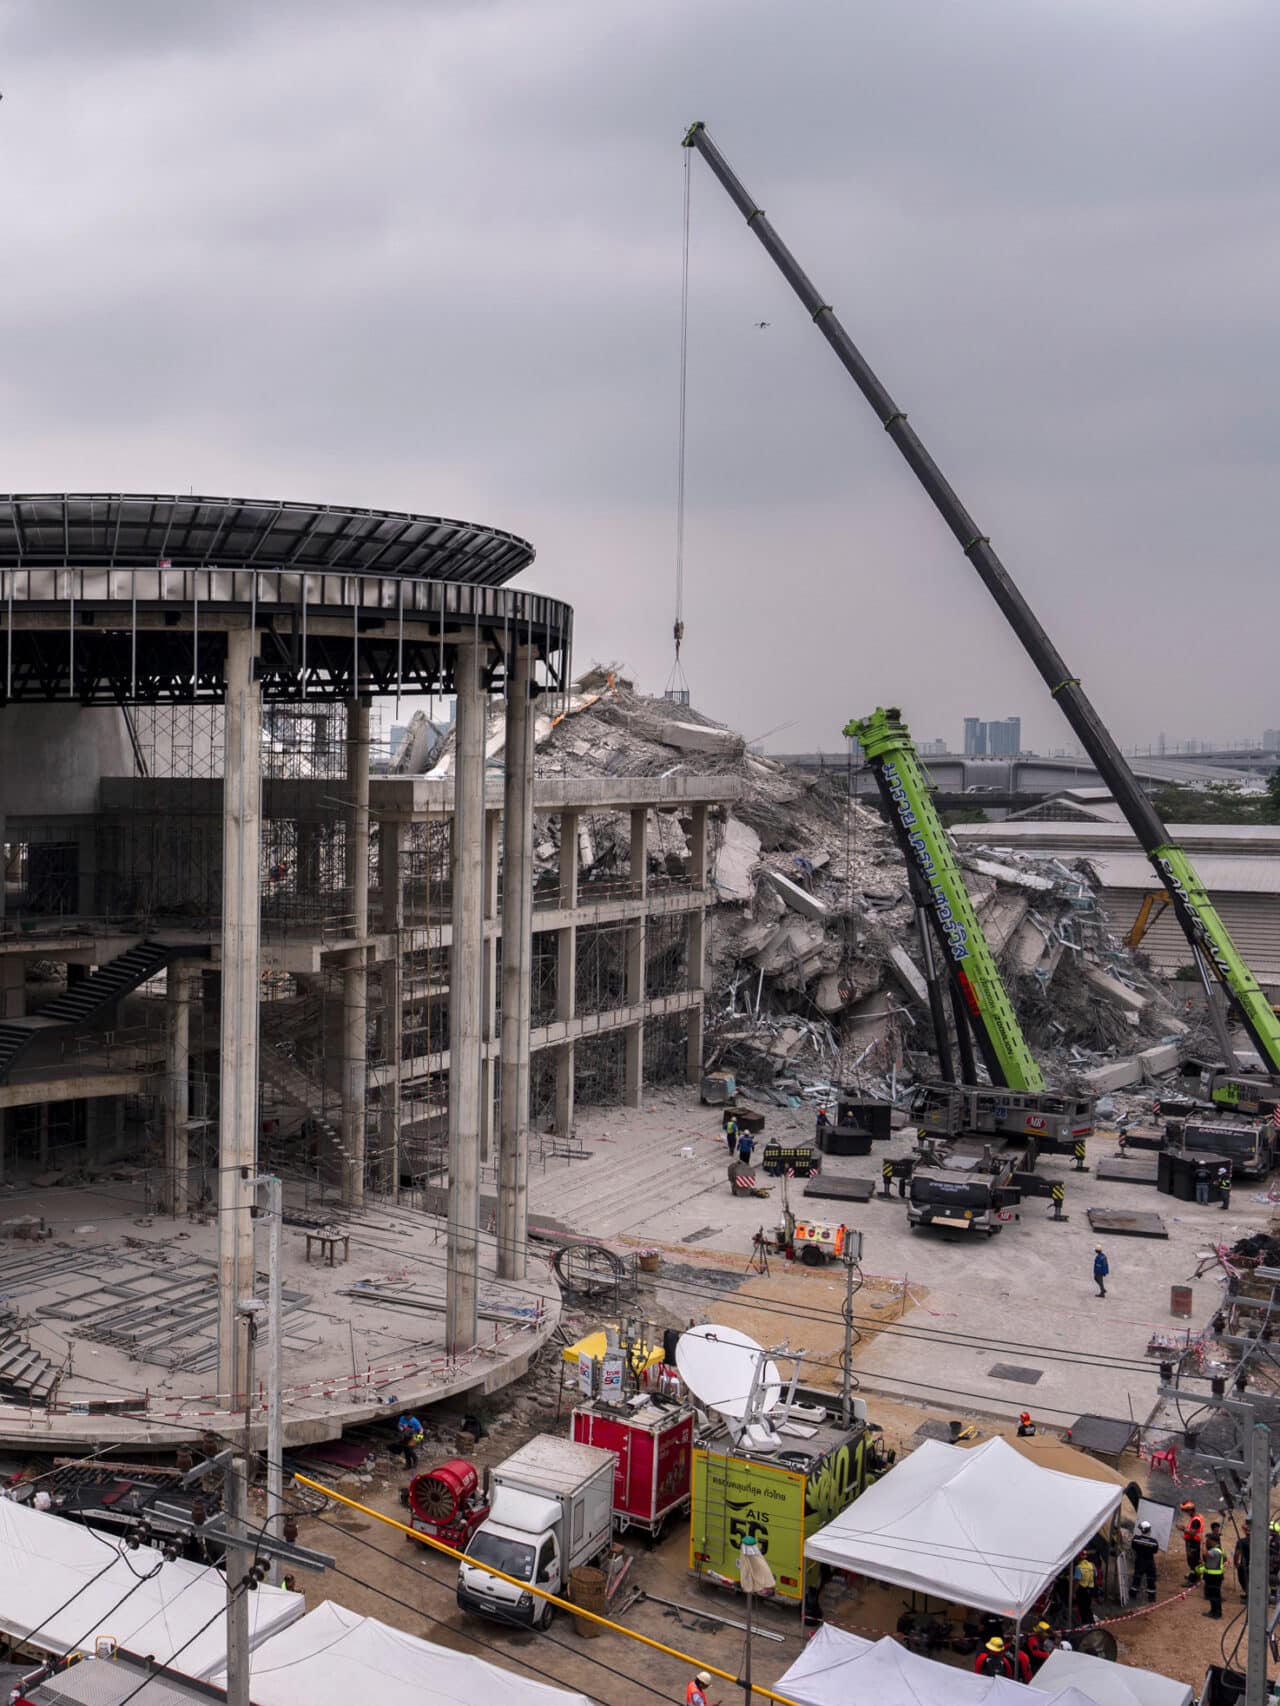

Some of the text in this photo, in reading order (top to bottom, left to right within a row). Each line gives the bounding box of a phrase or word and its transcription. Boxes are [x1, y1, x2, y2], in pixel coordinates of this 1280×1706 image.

[882, 762, 917, 829] มารวย
[908, 829, 939, 881] เครน
[604, 1376, 620, 1385] 5G
[745, 1509, 770, 1523] AIS
[729, 1516, 769, 1556] 5G
